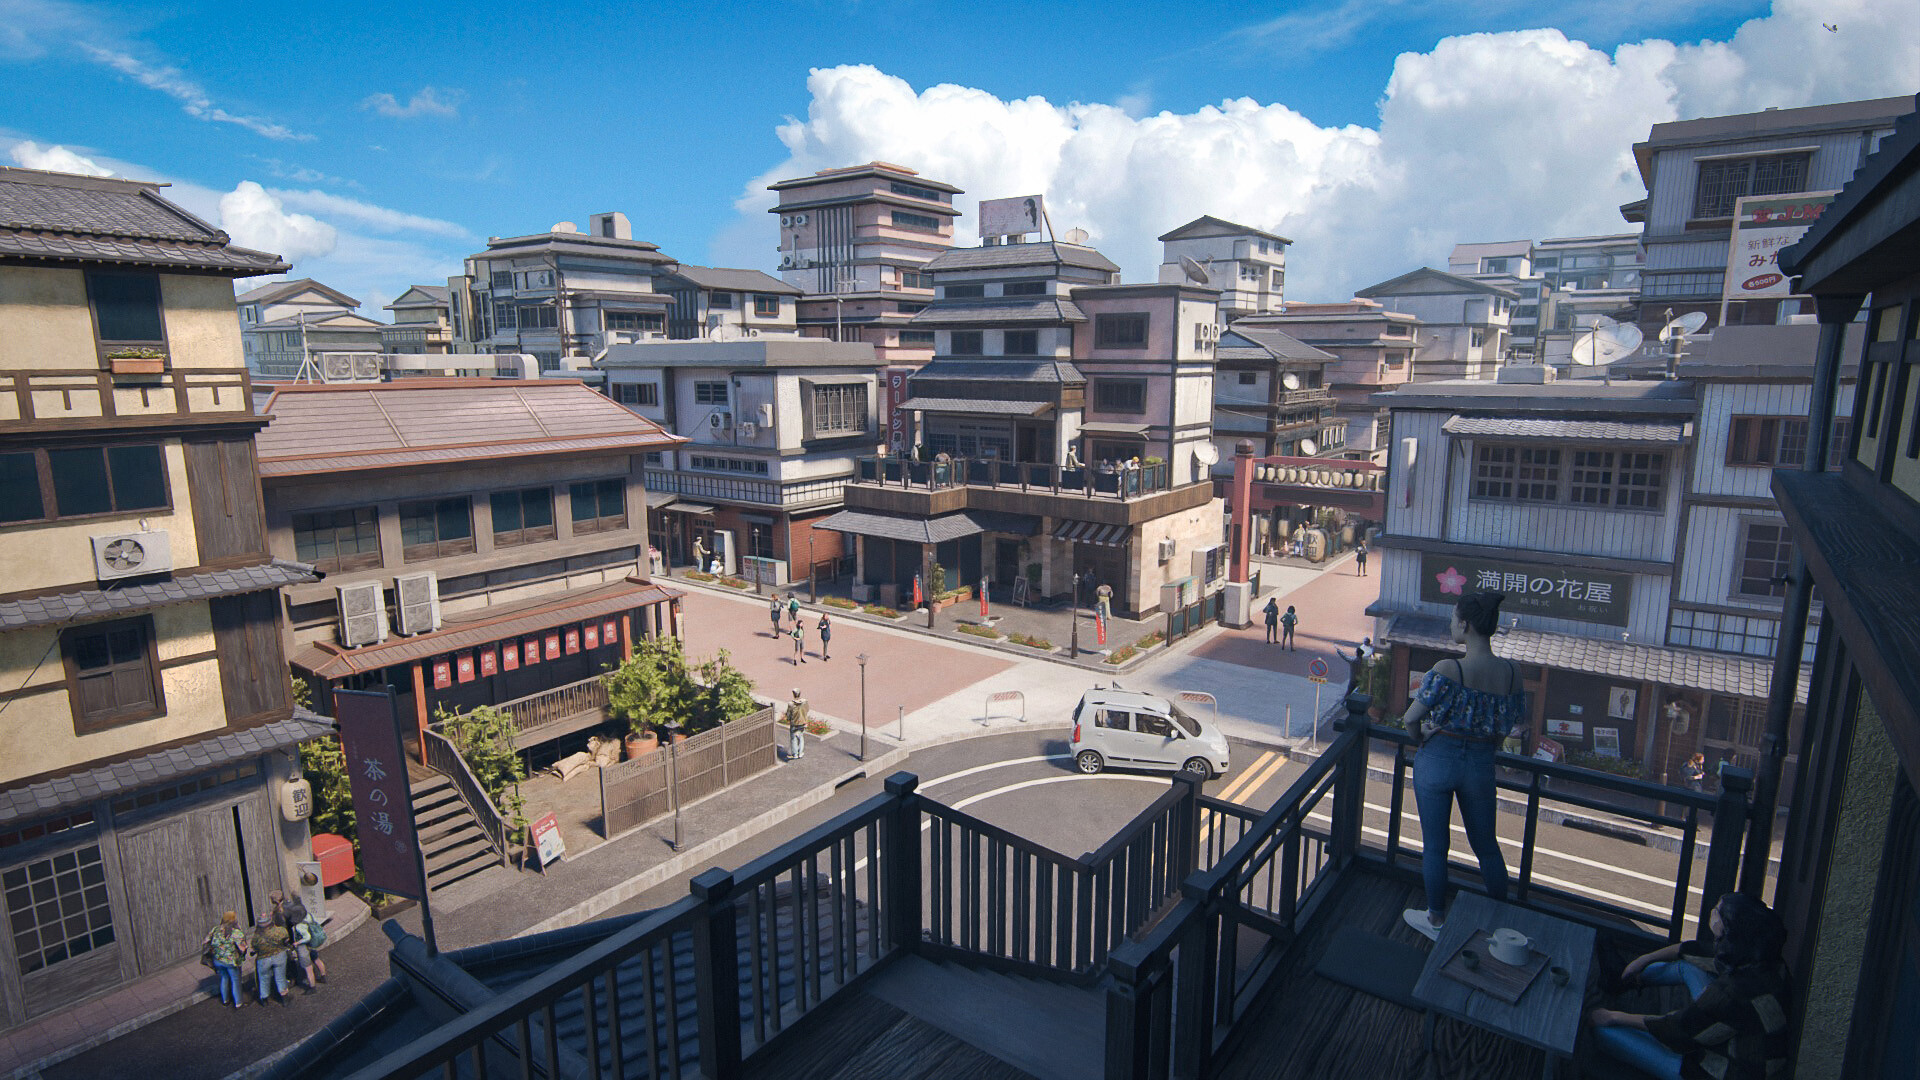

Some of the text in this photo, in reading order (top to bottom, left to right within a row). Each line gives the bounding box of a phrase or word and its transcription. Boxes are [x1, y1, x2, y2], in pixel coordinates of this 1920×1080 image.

[1747, 236, 1790, 250] 新鮮な
[1475, 569, 1613, 604] 満開の花屋
[292, 788, 310, 818] 歓迎
[363, 758, 393, 836] 茶の湯
